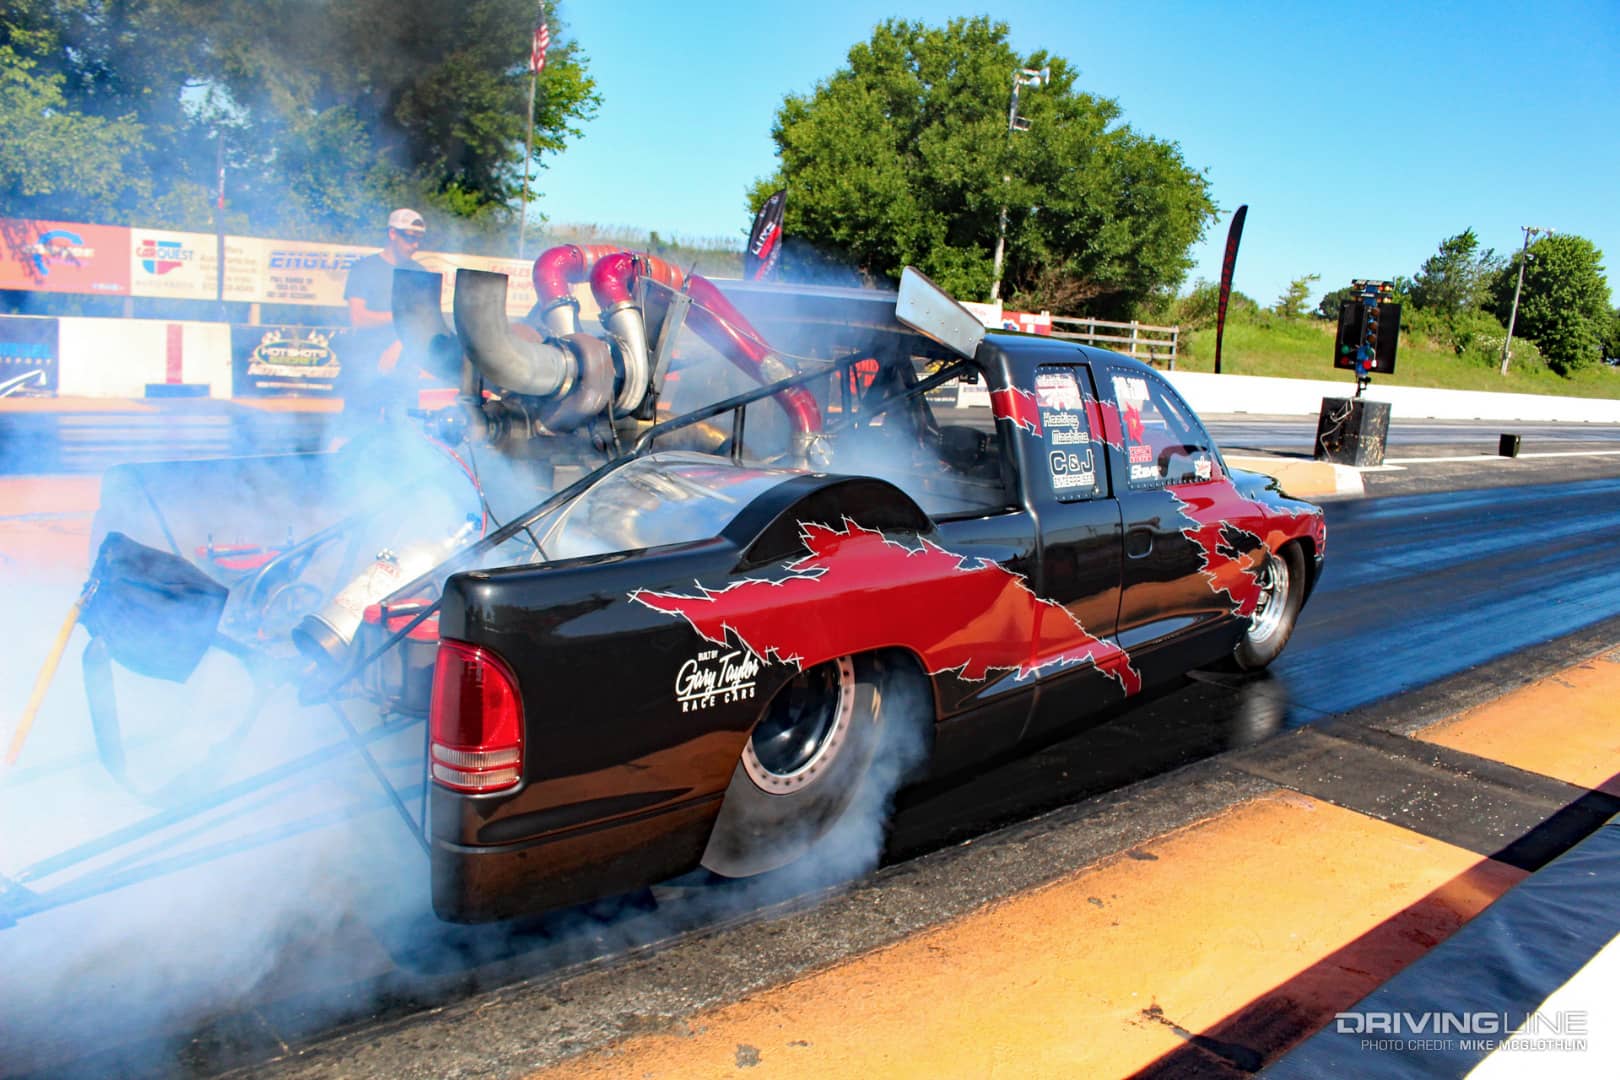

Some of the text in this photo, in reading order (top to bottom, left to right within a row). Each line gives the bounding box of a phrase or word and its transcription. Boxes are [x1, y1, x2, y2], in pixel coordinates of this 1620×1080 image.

[268, 251, 361, 271] ENGLIS
[1049, 449, 1093, 475] C&J
[675, 650, 759, 698] Gary Taylor
[682, 687, 755, 712] RACE CARS
